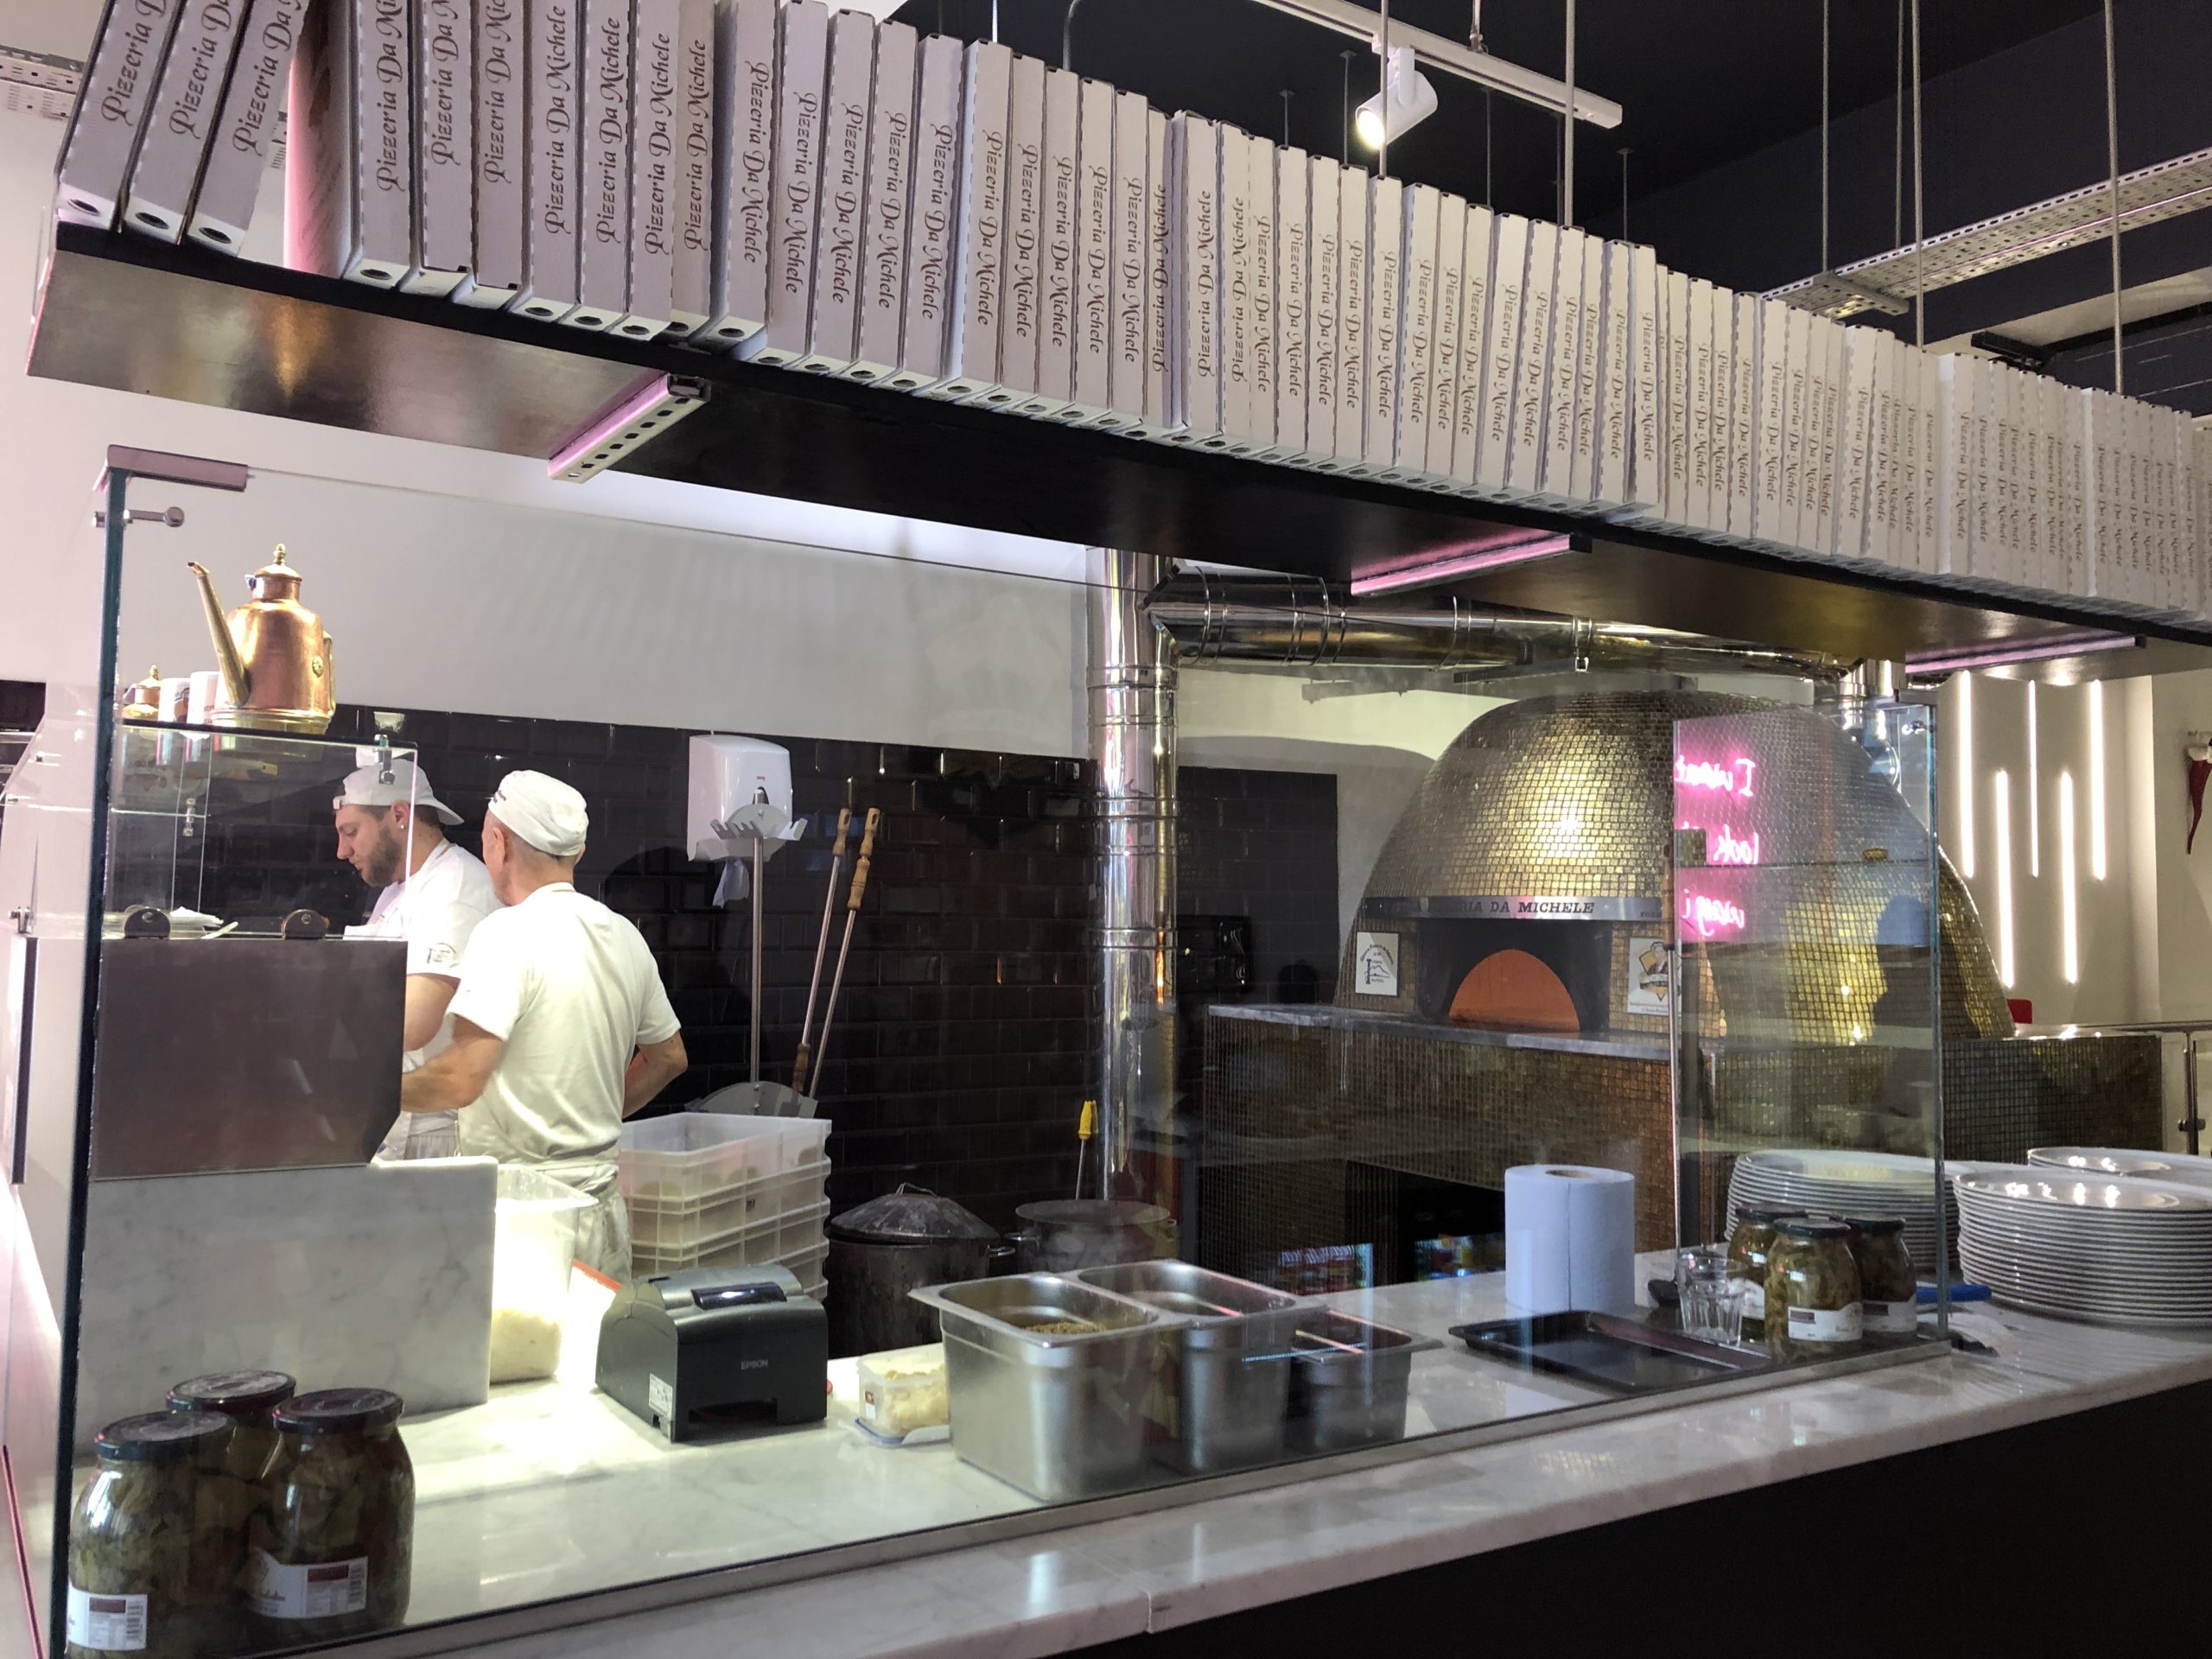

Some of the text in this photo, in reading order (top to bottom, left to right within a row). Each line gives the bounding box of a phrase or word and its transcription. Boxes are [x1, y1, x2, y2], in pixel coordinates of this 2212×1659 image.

[101, 21, 152, 126] Pizzeria
[169, 37, 218, 140] Pizzeria
[232, 10, 292, 156] Pizzeria Da
[376, 43, 403, 84] Da
[432, 23, 459, 60] Da
[432, 68, 461, 166] Pizzeria
[485, 46, 512, 84] Da
[544, 5, 571, 235] Pizzeria Da Michele
[376, 91, 405, 192] Pizzeria
[484, 91, 512, 184] Pizzeria
[596, 17, 624, 244] Pizzeria Da Michele
[645, 33, 673, 256] Pizzeria Da Michele
[683, 40, 709, 251] Pizzeria Da Michele
[740, 60, 770, 263] Pizzeria Da Michele
[783, 91, 817, 293] Pizzeria Da Michele
[830, 103, 864, 303] Pizzeria Da Michele
[876, 111, 907, 309] Pizzeria Da Michele
[920, 124, 953, 319] Pizzeria Da Michele
[976, 129, 1003, 325] Pizzeria Da Michele
[1014, 143, 1038, 337] Pizzeria Da Michele
[1049, 156, 1073, 346] Pizzeria Da Michele
[1087, 165, 1108, 354] Pizzeria Da Michele
[1122, 176, 1142, 362] Pizzeria Da Michele
[1152, 184, 1169, 372] Pizzeria Da Michele
[1198, 190, 1215, 377] Pizzeria Da Michele
[1231, 197, 1248, 382] Pizzeria Da Michele
[1254, 214, 1271, 392] Pizzeria Da Michele
[1287, 221, 1303, 396] Pizzeria Da Michele
[1316, 233, 1335, 405] Pizzeria Da Michele
[1344, 238, 1363, 409] Pizzeria Da Michele
[1376, 251, 1397, 418] Pizzeria Da Michele
[1409, 258, 1432, 423] Pizzeria Da Michele
[1437, 266, 1459, 429] Pizzeria Da Michele
[1460, 276, 1484, 435] Pizzeria Da Michele
[1491, 283, 1517, 442] Pizzeria Da Michele
[1523, 291, 1548, 447] Pizzeria Da Michele
[1490, 901, 1510, 913] DA
[1517, 901, 1595, 913] MICHELE
[741, 1359, 768, 1370] EPSON
